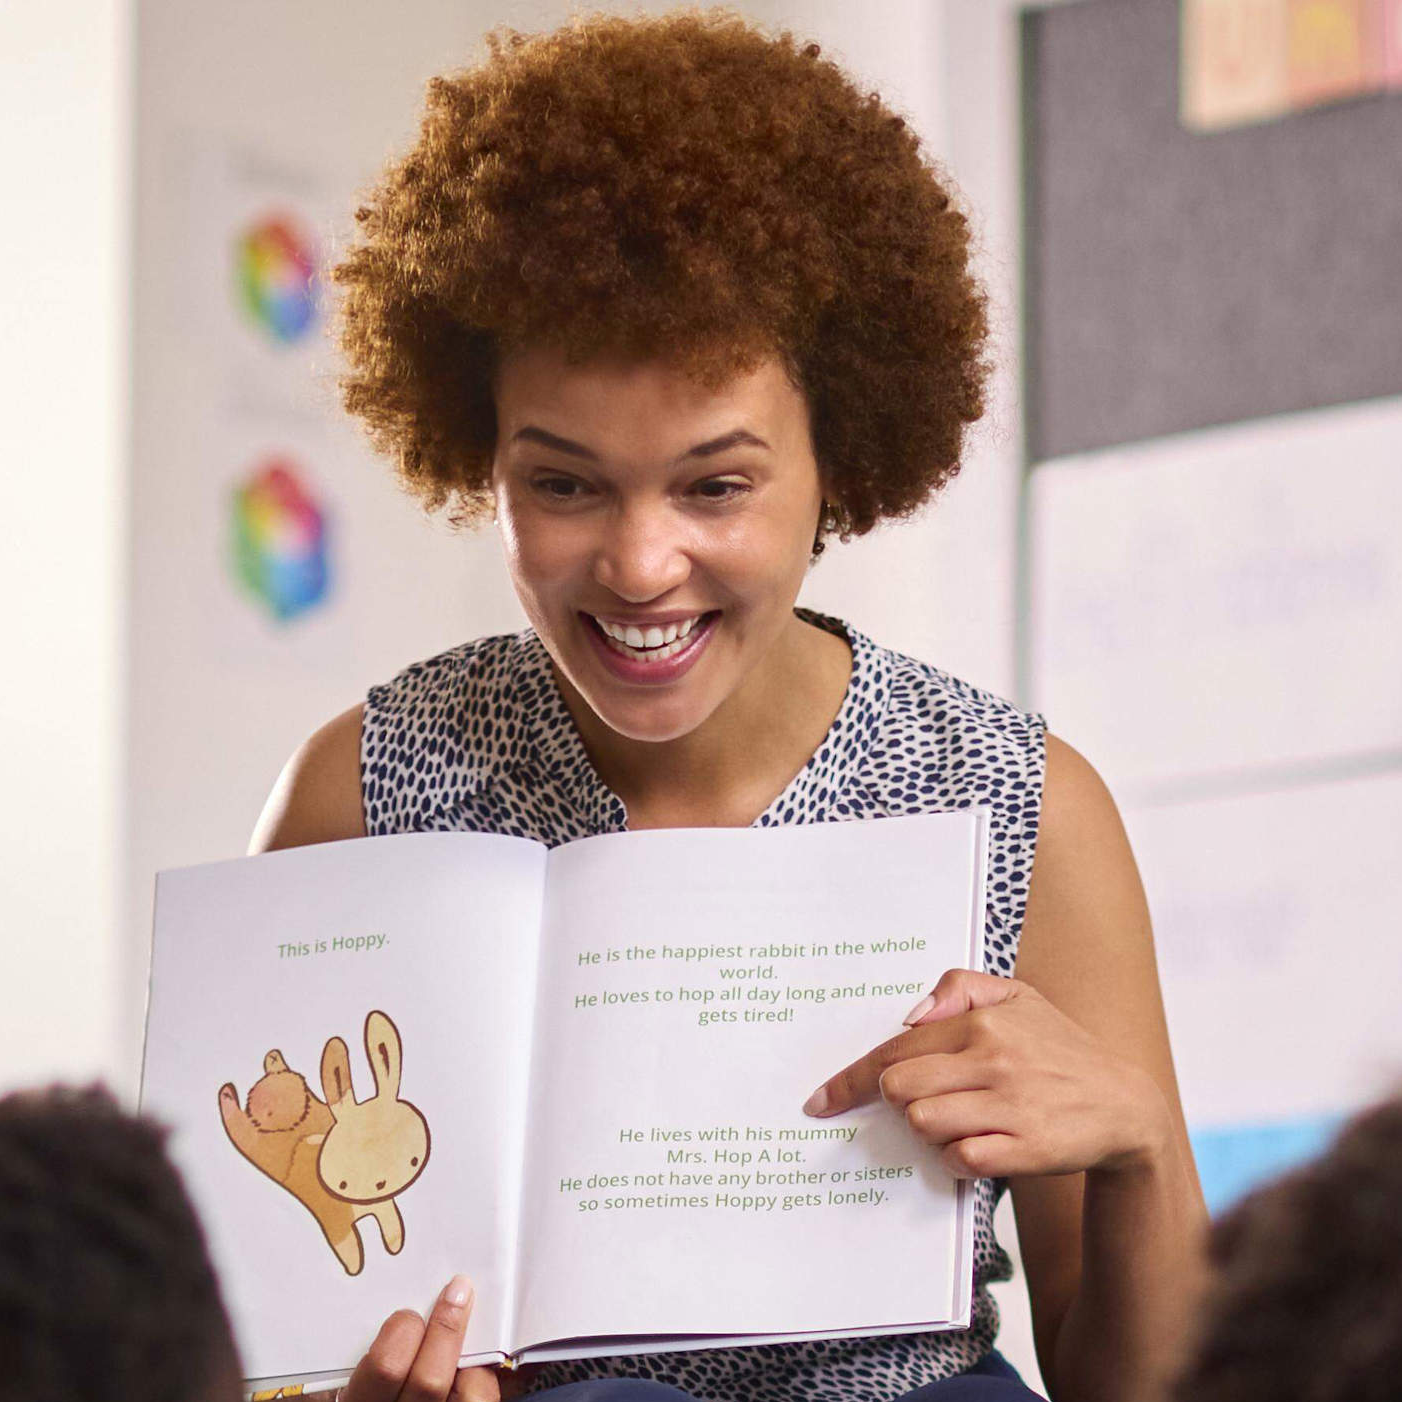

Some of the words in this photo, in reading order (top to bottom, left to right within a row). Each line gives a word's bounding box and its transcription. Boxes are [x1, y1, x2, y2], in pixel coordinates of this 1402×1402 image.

[278, 942, 310, 958] This
[314, 938, 328, 954] is
[333, 934, 390, 952] Hoppy.
[578, 952, 601, 966] He
[606, 947, 621, 963] is
[626, 946, 656, 960] the
[662, 944, 742, 962] happiest
[750, 944, 806, 958] rabbit
[811, 943, 828, 957] in
[835, 941, 864, 955] the
[871, 937, 926, 953] whole
[720, 965, 777, 979] world.
[575, 994, 597, 1008] He
[603, 990, 649, 1004] loves
[655, 989, 674, 1002] to
[679, 987, 714, 1004] hop
[720, 987, 741, 1000] all
[747, 986, 781, 1004] day
[787, 986, 825, 1003] long
[831, 983, 865, 998] and
[872, 983, 923, 996] never
[698, 1010, 737, 1026] gets
[744, 1008, 793, 1022] tired!
[620, 1129, 644, 1143] He
[651, 1128, 692, 1142] lives
[698, 1127, 738, 1141] with
[746, 1127, 772, 1141] his
[779, 1127, 858, 1143] mummy
[667, 1150, 706, 1163] Mrs.
[715, 1149, 752, 1167] Hop
[757, 1148, 772, 1163] A
[777, 1148, 806, 1163] lot.
[560, 1178, 582, 1192] He
[587, 1174, 628, 1189] does
[633, 1173, 665, 1187] not
[670, 1171, 713, 1185] have
[718, 1172, 751, 1189] any
[757, 1168, 827, 1184] brother
[830, 1170, 851, 1184] or
[855, 1164, 913, 1180] sisters
[578, 1199, 599, 1212] so
[604, 1194, 708, 1209] sometimes
[716, 1193, 777, 1211] Hoppy
[782, 1194, 821, 1211] gets
[829, 1188, 889, 1206] lonely.
